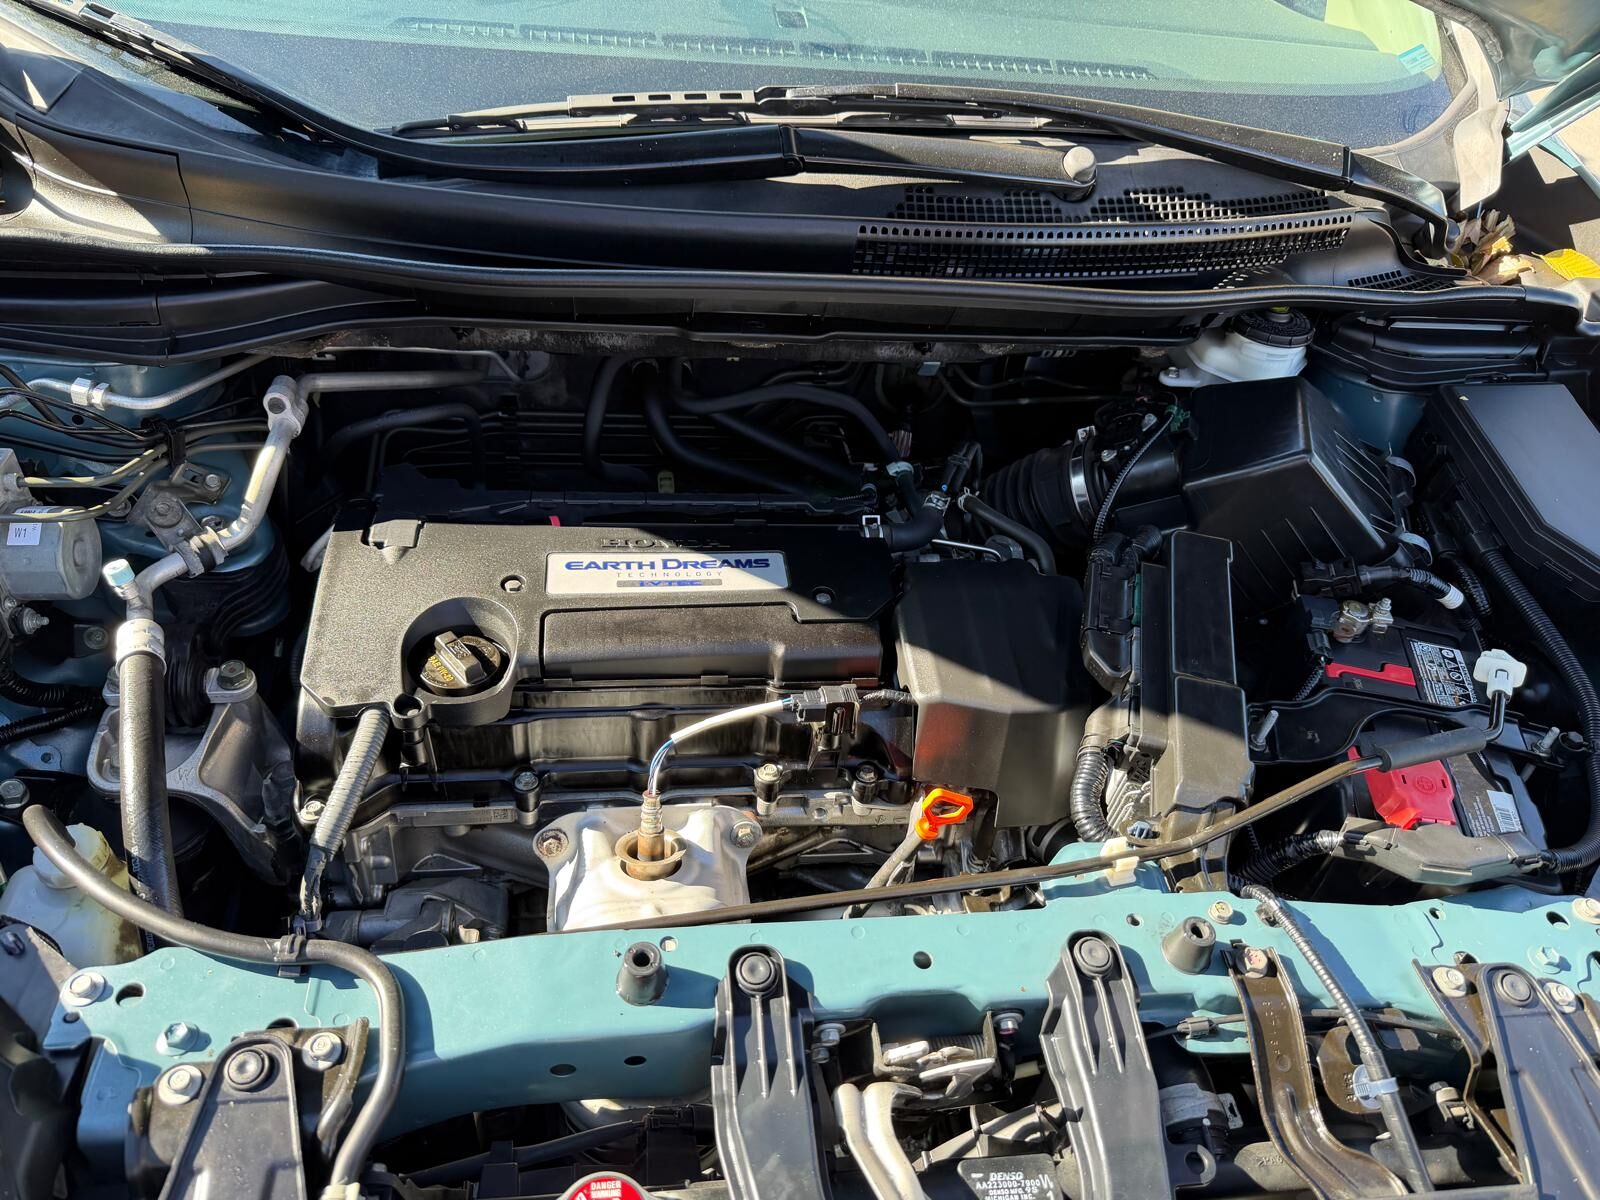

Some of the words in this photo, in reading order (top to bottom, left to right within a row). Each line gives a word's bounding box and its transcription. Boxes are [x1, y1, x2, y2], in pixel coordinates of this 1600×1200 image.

[14, 527, 27, 538] W1
[564, 560, 656, 571] EARTH
[661, 558, 771, 570] DREAMS
[616, 571, 723, 579] TECHNOLOGY
[989, 1172, 1024, 1181] DENSO
[590, 1180, 622, 1190] DANGER
[590, 1189, 622, 1198] WARNING
